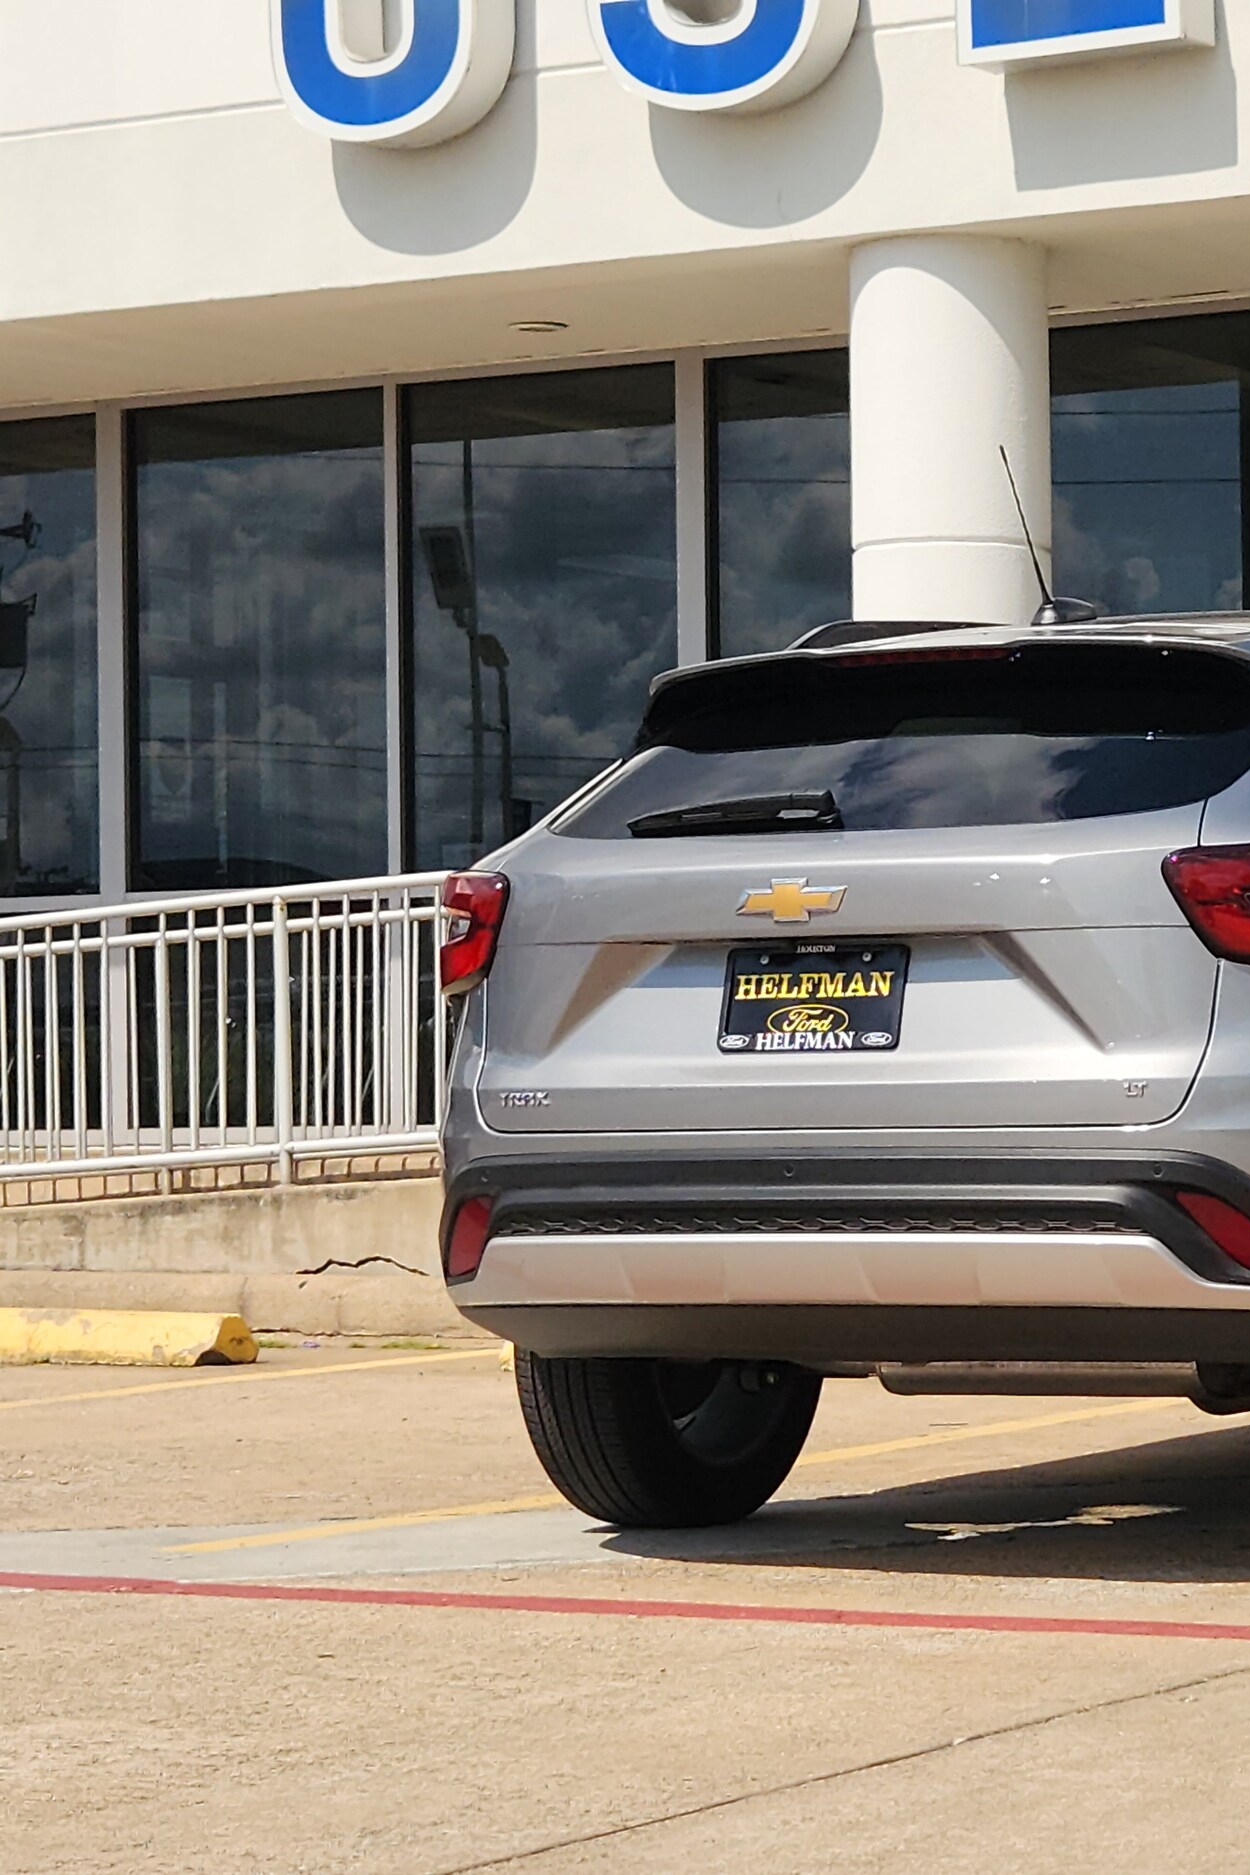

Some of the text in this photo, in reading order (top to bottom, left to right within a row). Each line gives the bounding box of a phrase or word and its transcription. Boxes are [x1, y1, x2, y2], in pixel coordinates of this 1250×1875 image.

[734, 971, 896, 1000] HELFMAN
[782, 1008, 835, 1032] Ford
[754, 1031, 856, 1050] HELFMAN
